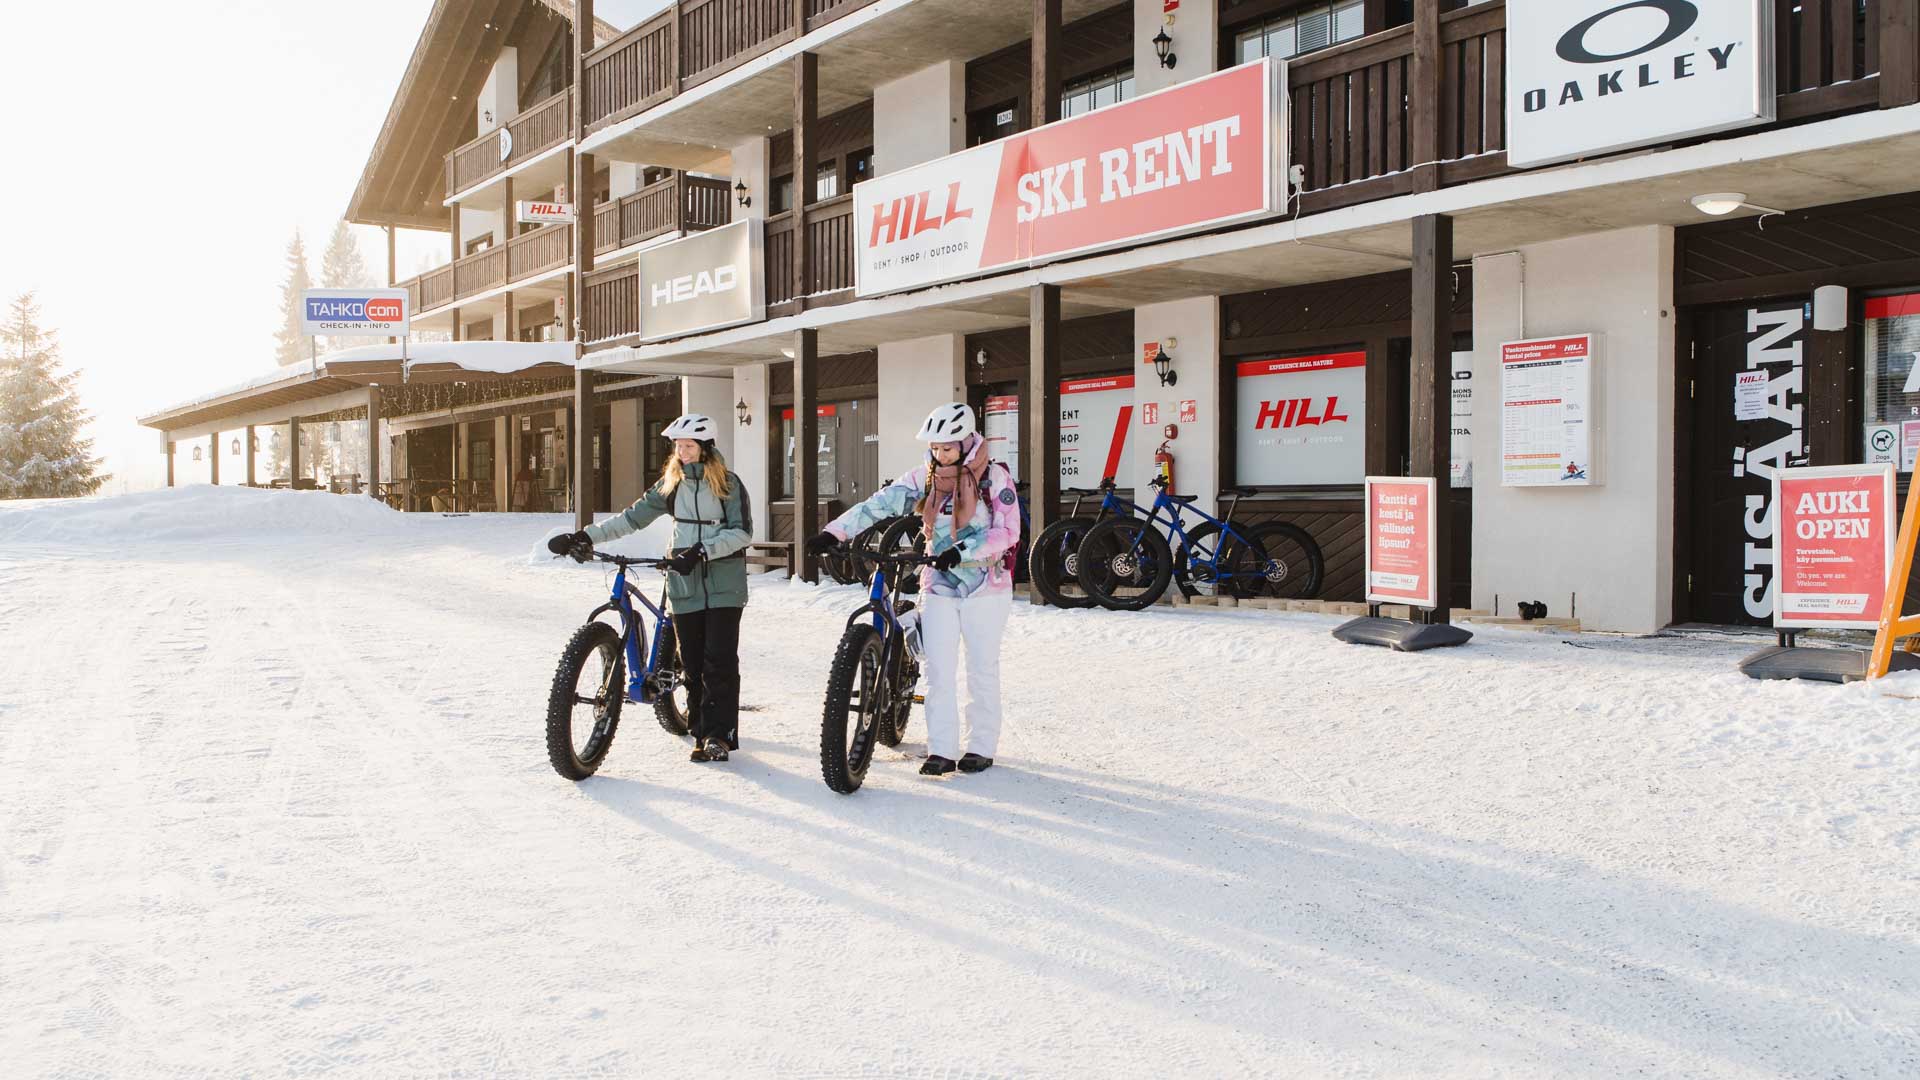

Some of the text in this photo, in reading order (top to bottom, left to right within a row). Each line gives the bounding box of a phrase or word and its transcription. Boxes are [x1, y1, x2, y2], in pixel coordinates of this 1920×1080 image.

[1523, 42, 1736, 112] OAKLEY
[1017, 114, 1240, 223] SKI RENT
[530, 204, 566, 215] HILL
[869, 181, 974, 248] HILL
[901, 252, 920, 264] SHOP
[930, 241, 969, 257] OUTDOOR
[651, 264, 737, 307] HEAD
[310, 303, 399, 317] TAHKO com
[1268, 362, 1299, 371] EXPERIENCE
[1739, 375, 1764, 384] HILL
[1061, 410, 1079, 420] ENT
[1255, 396, 1348, 430] HILL
[1061, 434, 1079, 444] HOP
[1061, 456, 1077, 465] UT-
[1061, 467, 1078, 475] OOR
[1378, 494, 1417, 505] Kantti ei
[1795, 490, 1870, 515] AUKI
[1379, 508, 1414, 521] kestä ja
[1796, 518, 1870, 540] OPEN
